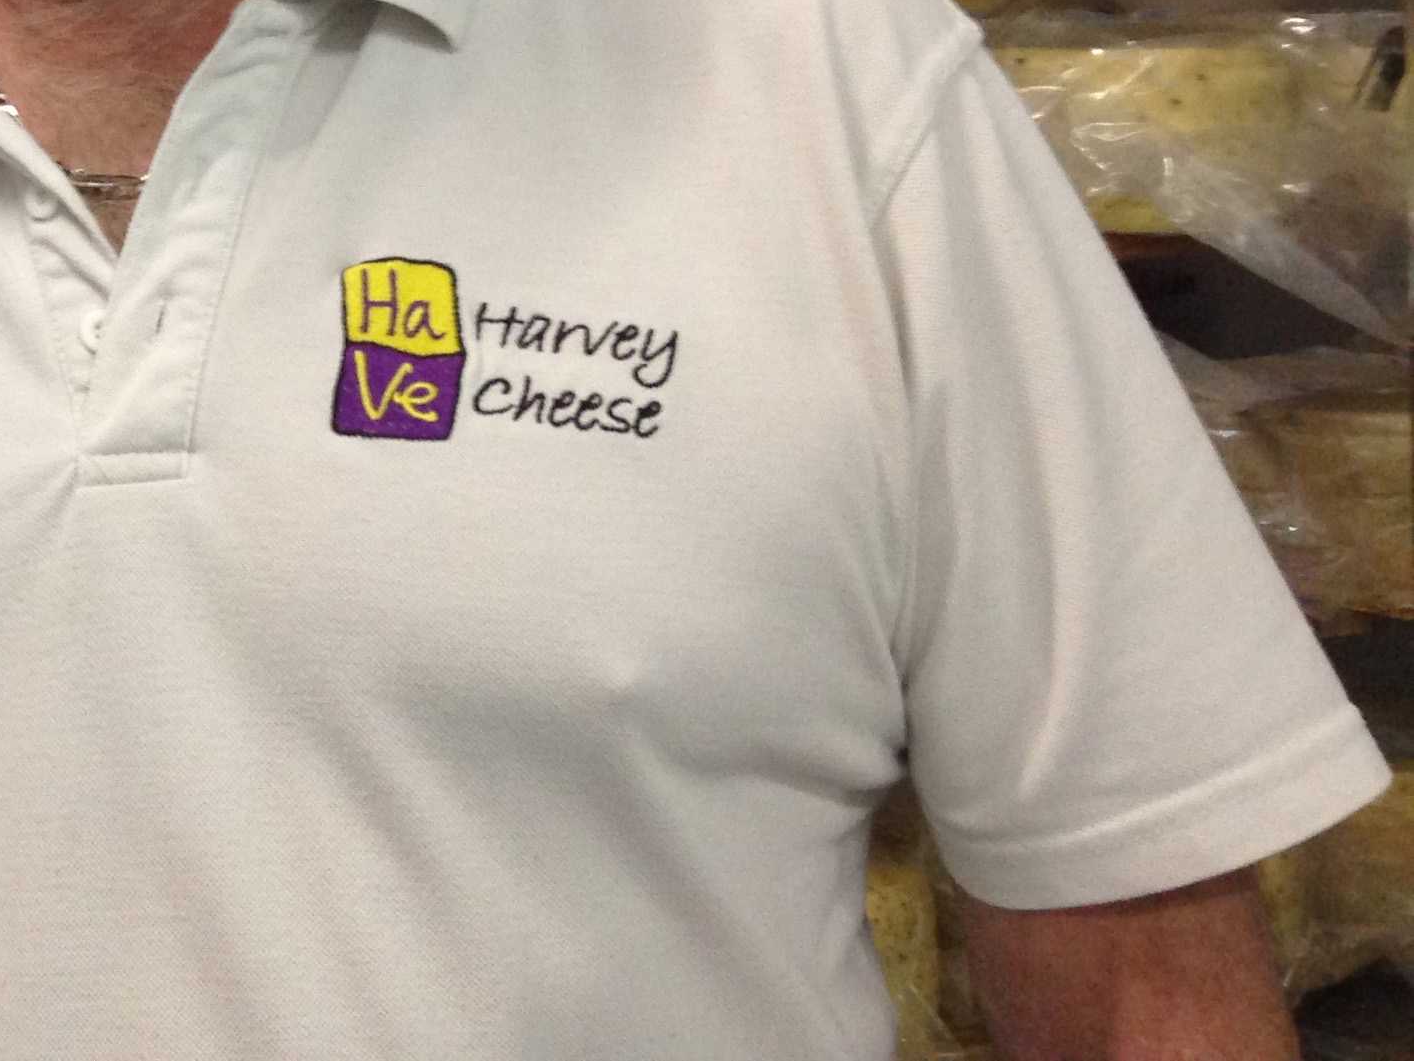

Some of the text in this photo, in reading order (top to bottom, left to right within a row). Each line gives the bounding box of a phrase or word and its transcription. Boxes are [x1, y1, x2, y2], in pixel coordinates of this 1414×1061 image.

[359, 268, 446, 340] Ha
[475, 302, 678, 388] Harvey
[354, 350, 439, 421] Ve
[472, 375, 662, 438] Cheese
